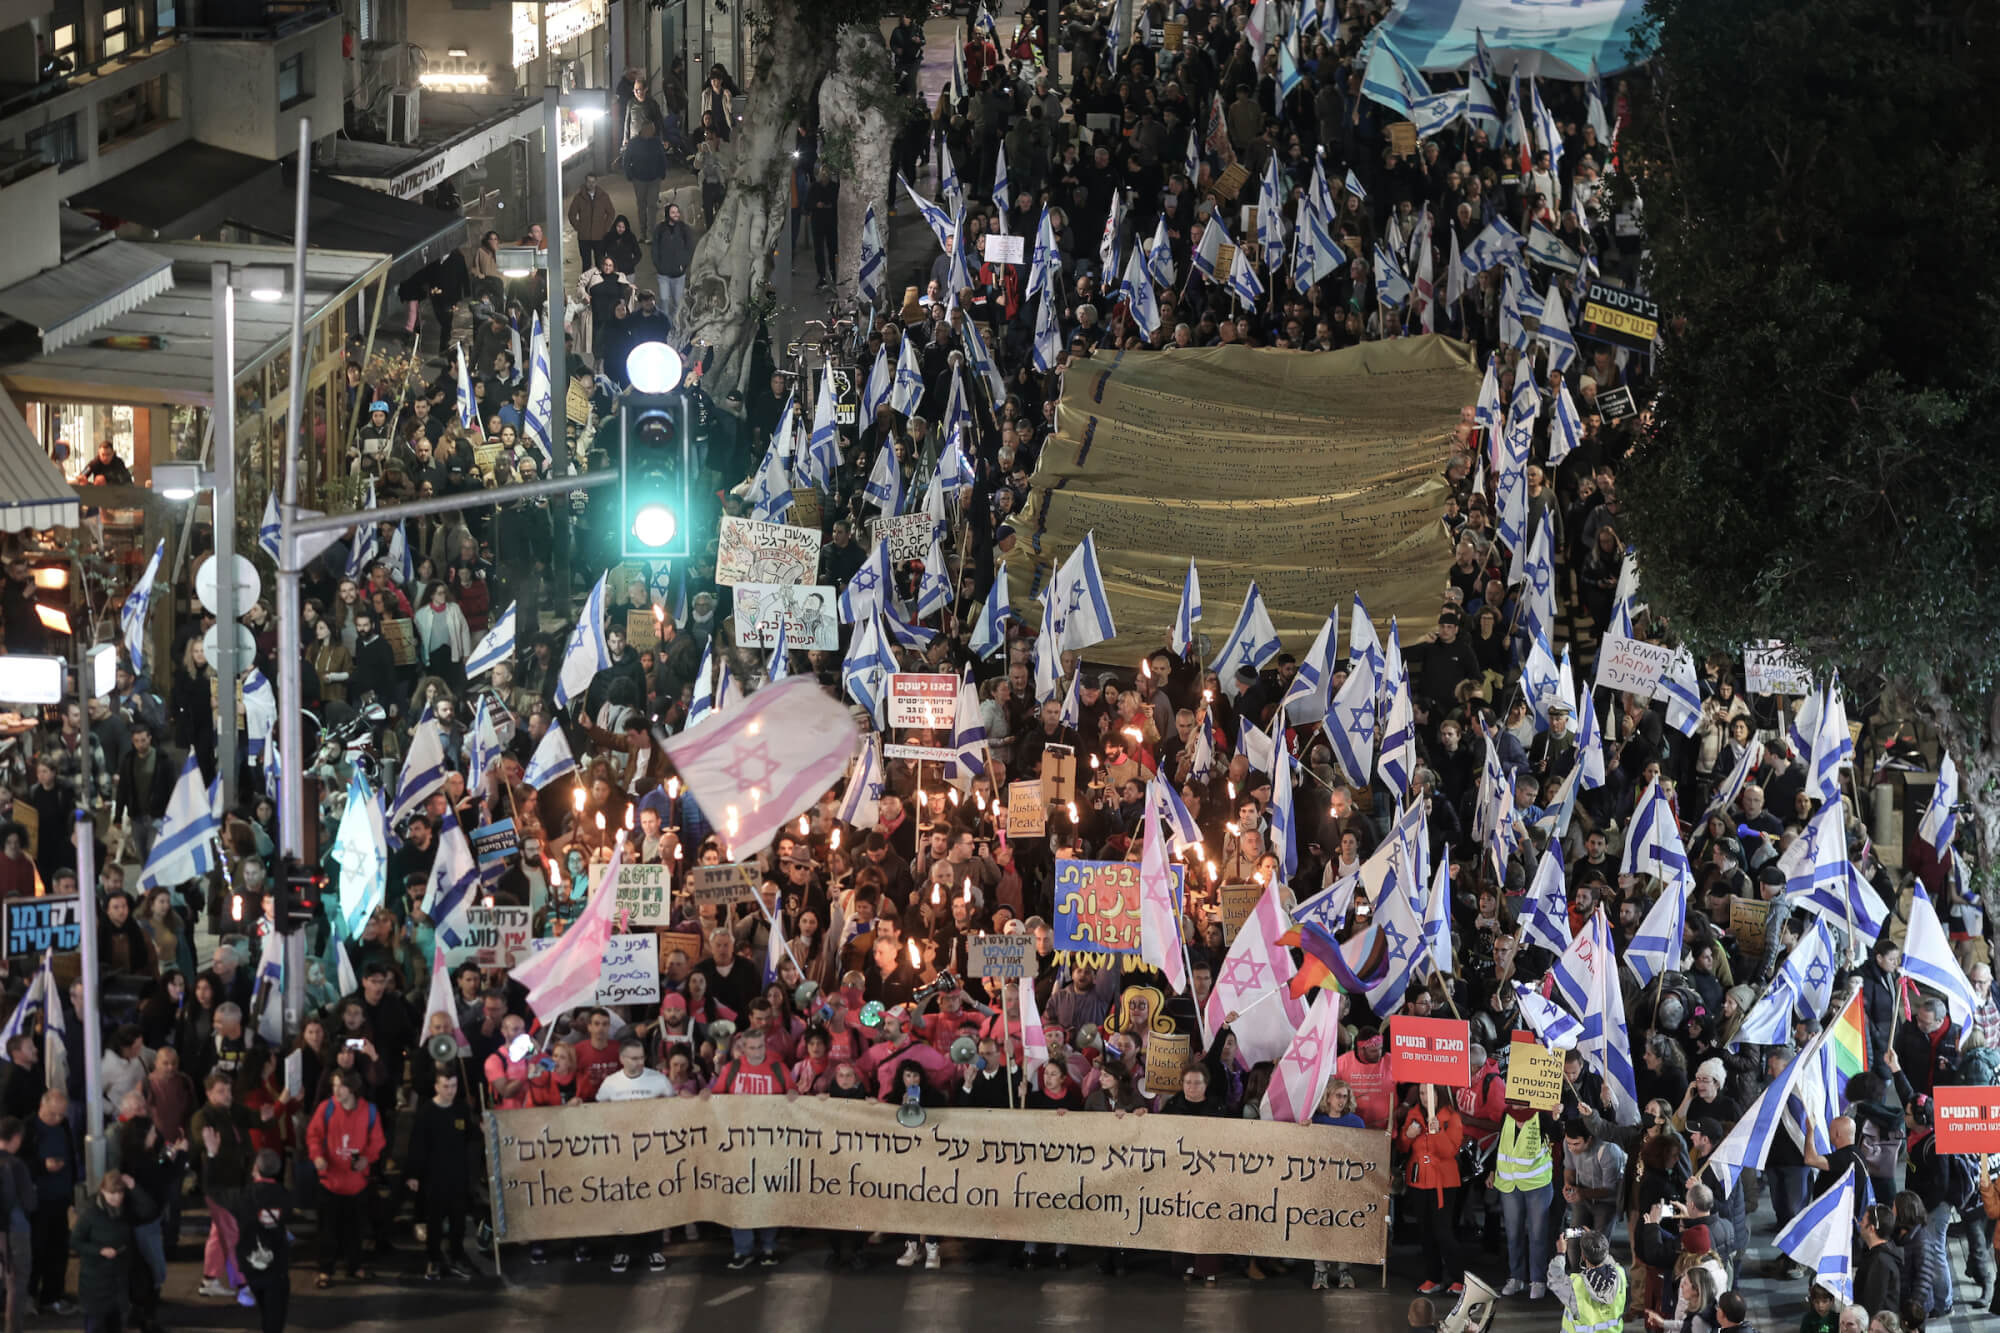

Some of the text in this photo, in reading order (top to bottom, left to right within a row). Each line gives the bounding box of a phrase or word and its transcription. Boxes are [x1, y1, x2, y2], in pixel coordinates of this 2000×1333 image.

[1590, 284, 1659, 318] ביביסטים
[1585, 304, 1658, 339] פשיסטים
[735, 520, 753, 531] על
[756, 521, 780, 538] יקום
[906, 526, 914, 537] IS
[916, 522, 931, 534] THE
[754, 532, 788, 548] רגליו
[890, 534, 924, 548] ND OF
[761, 620, 804, 632] הפכה
[1614, 640, 1671, 665] הממשלה
[1608, 653, 1655, 674] מחבלת
[896, 681, 954, 692] באנו לשקם
[906, 706, 944, 714] נותים גב
[897, 715, 954, 726] לדמקרטיה
[51, 900, 80, 927] רק
[10, 923, 80, 953] קרטיה
[983, 945, 1025, 957] המשפט
[1395, 1034, 1464, 1052] מאבק הנשים
[1529, 1057, 1563, 1069] הילדים
[1539, 1069, 1562, 1079] שלנו
[1512, 1076, 1560, 1090] מהשטחים
[1517, 1087, 1559, 1100] הכבושים
[1940, 1105, 1979, 1119] הנשים
[1948, 1122, 1964, 1132] שלנו
[632, 1125, 708, 1161] הצדק
[718, 1125, 823, 1154] החירות,
[829, 1127, 922, 1156] יסודות
[931, 1123, 970, 1164] על
[976, 1138, 1096, 1166] מושתתת
[1102, 1144, 1167, 1173] תהא
[1177, 1136, 1275, 1176] ישראל
[581, 1174, 652, 1204] State
[658, 1158, 688, 1196] of
[693, 1157, 756, 1195] Israel
[763, 1156, 802, 1194] will
[809, 1158, 841, 1197] be
[848, 1162, 959, 1205] founded
[966, 1183, 999, 1208] on
[1013, 1171, 1130, 1221] freedom,
[1129, 1185, 1222, 1237] justice
[1228, 1186, 1278, 1224] and
